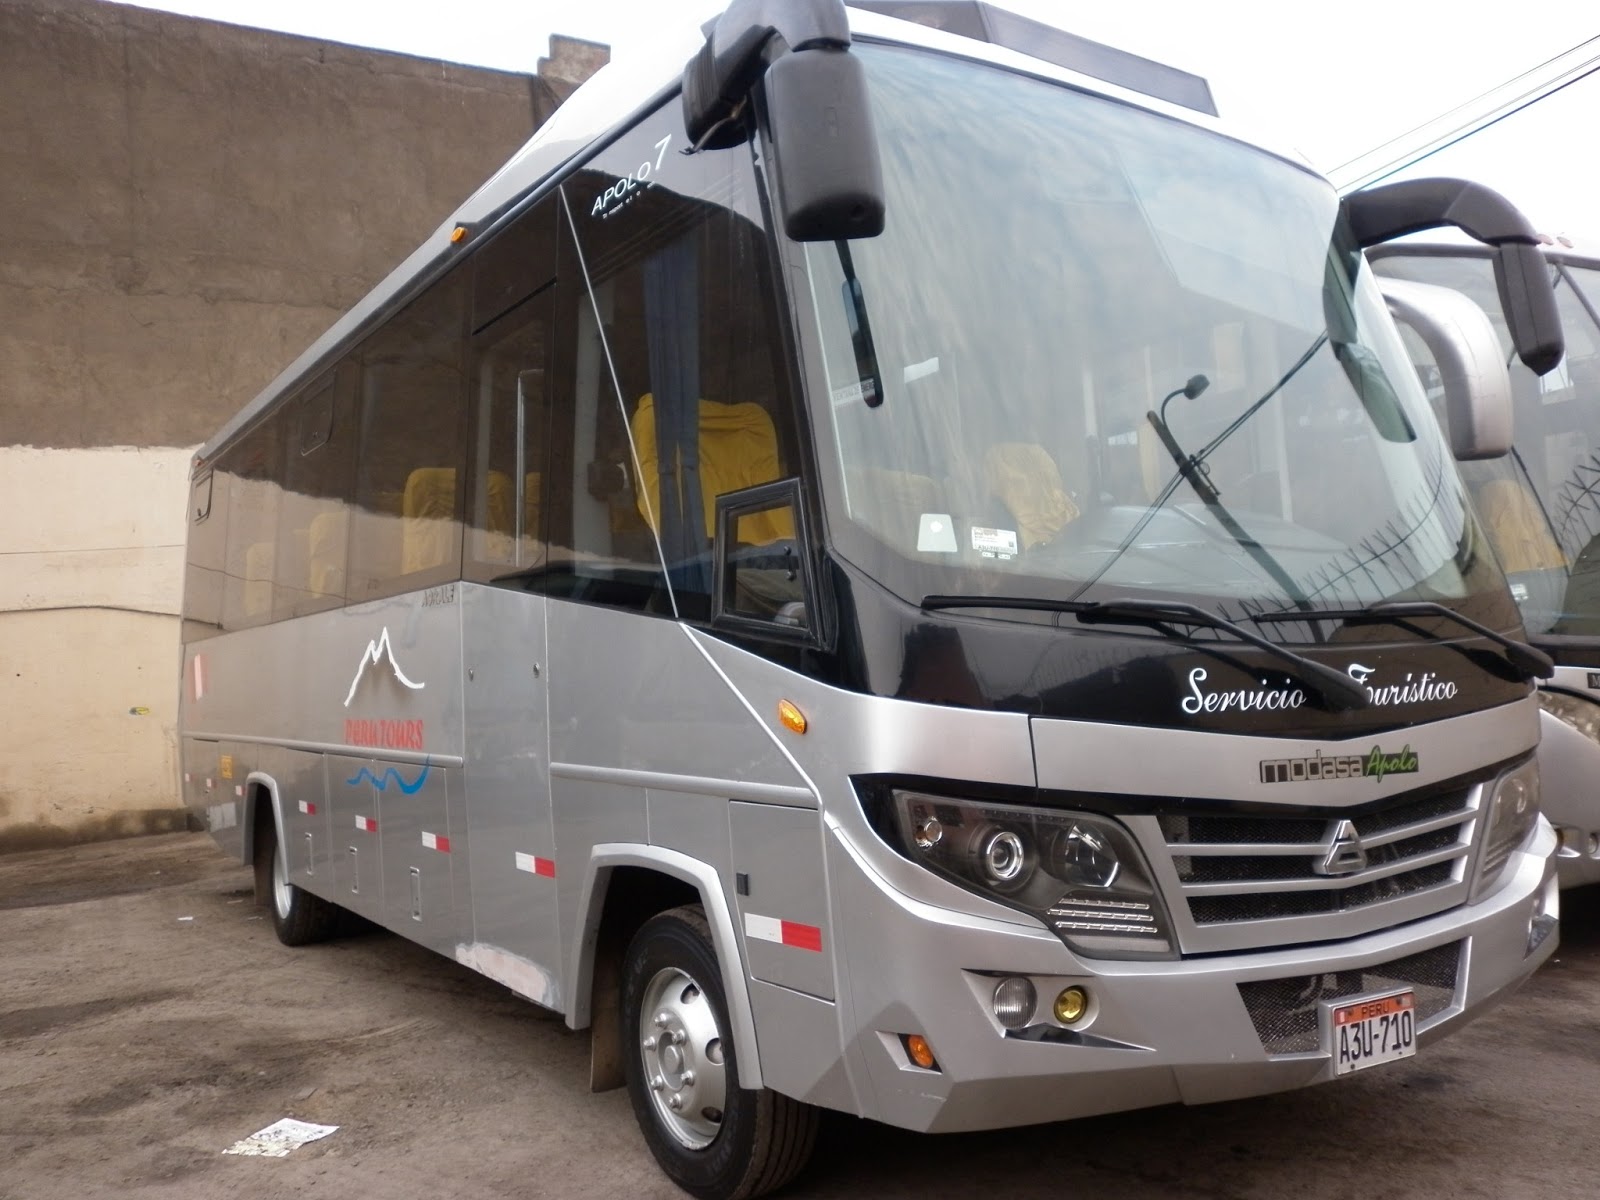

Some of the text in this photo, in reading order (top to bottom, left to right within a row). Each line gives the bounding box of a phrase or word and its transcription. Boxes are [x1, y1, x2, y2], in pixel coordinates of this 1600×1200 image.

[591, 161, 651, 216] APOLO
[1182, 667, 1307, 714] Servicio
[1260, 744, 1418, 783] modasa Apolo
[1361, 1001, 1390, 1018] PERU
[1340, 1010, 1412, 1064] A3U-710
